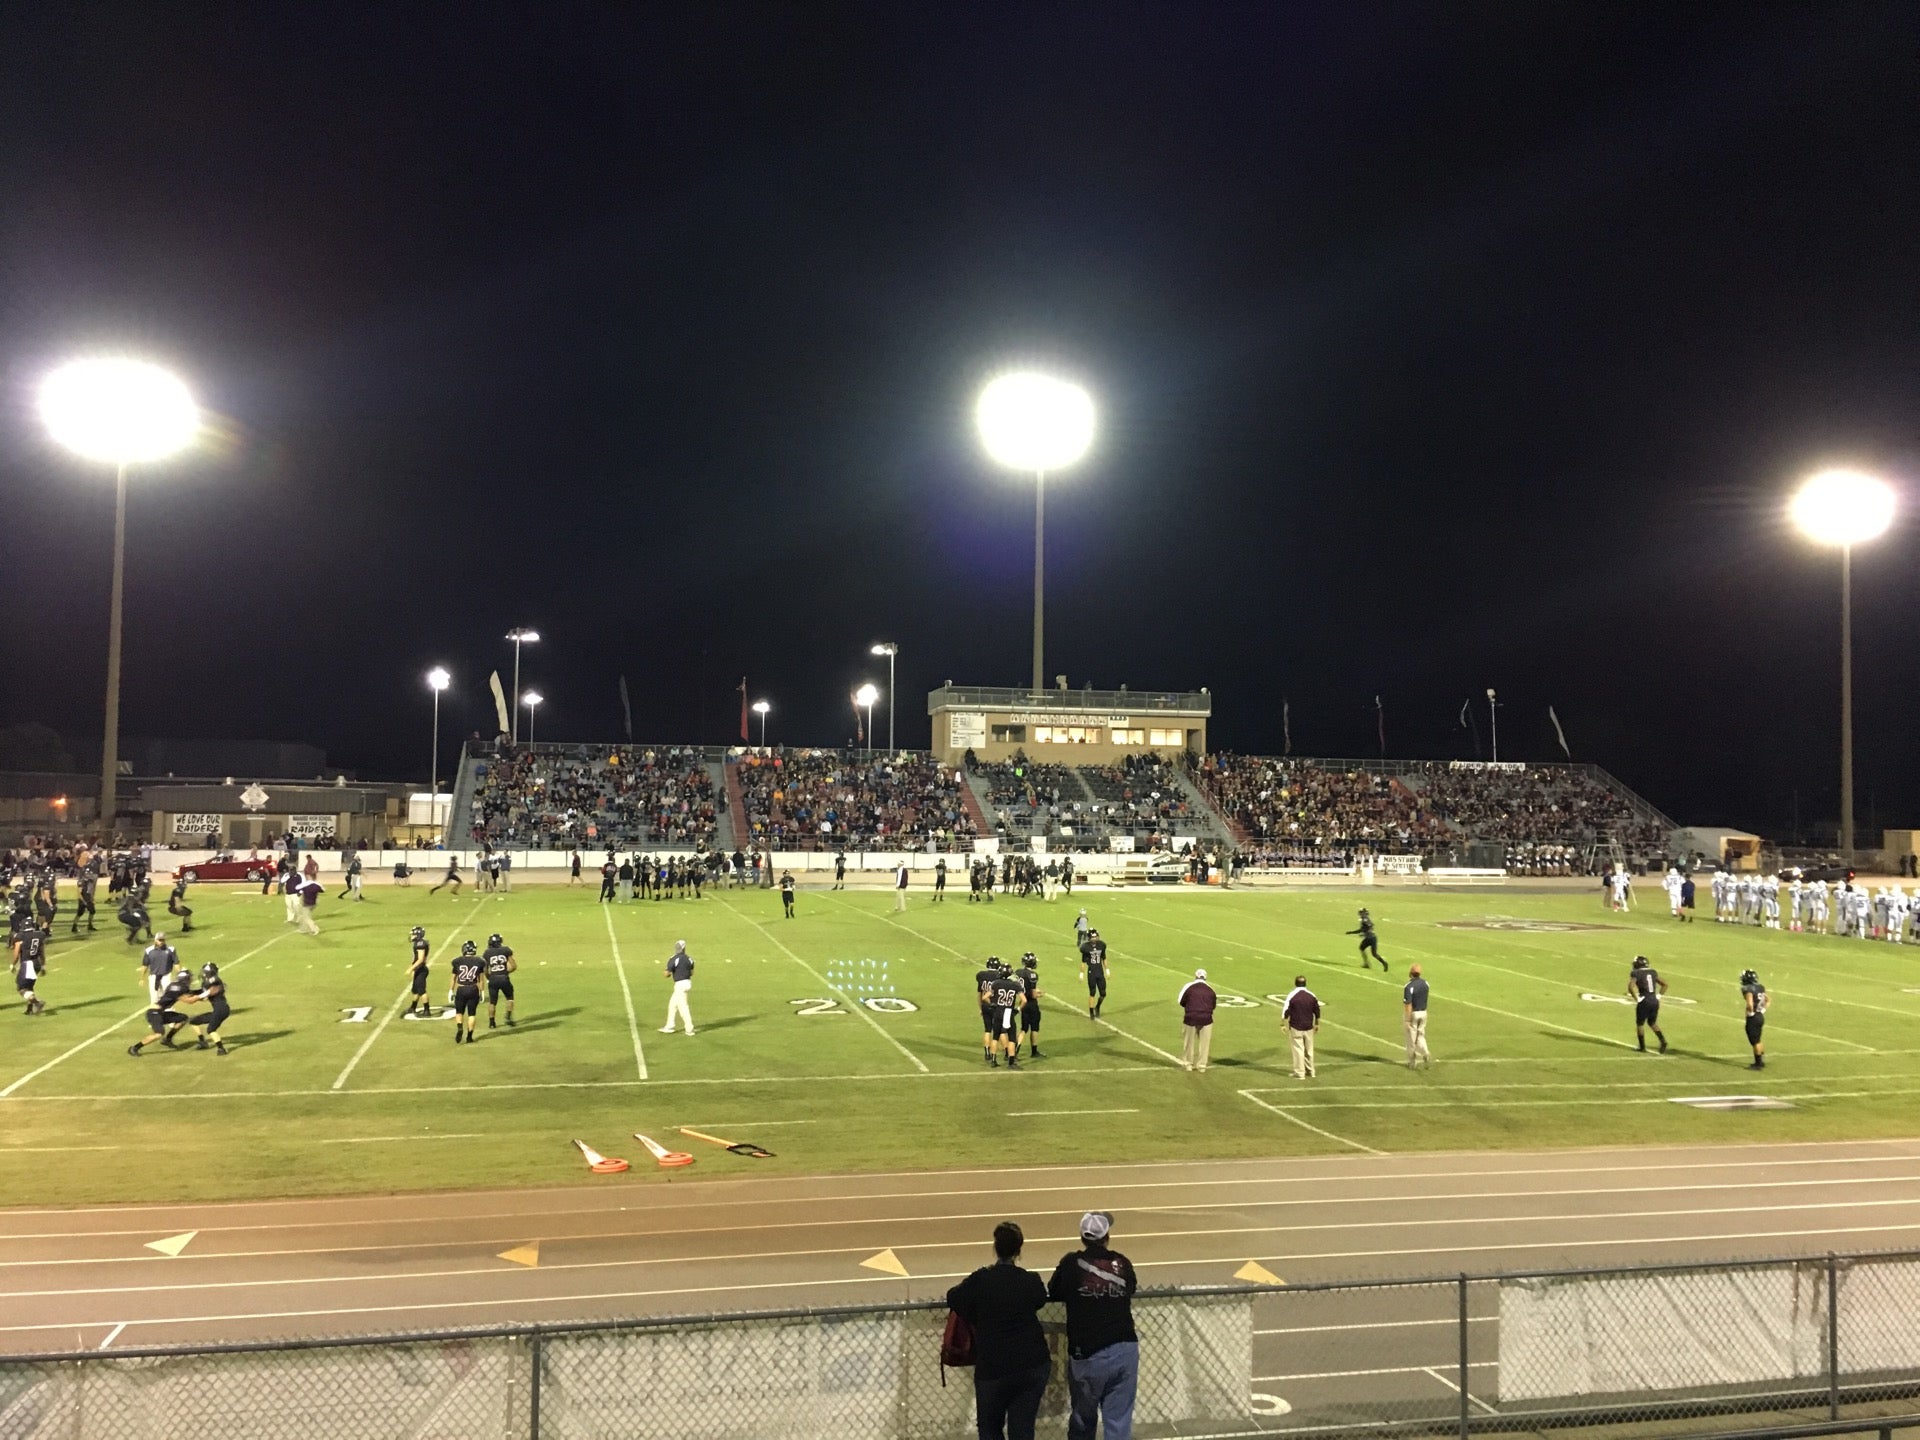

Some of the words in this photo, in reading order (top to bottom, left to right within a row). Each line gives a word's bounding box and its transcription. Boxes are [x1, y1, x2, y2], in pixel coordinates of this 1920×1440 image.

[177, 814, 186, 824] WE
[188, 814, 205, 824] LOVE
[206, 815, 220, 824] OUR
[177, 824, 220, 833] RAIDERS
[291, 825, 334, 834] RAIDERS
[30, 938, 40, 956] 5
[458, 964, 478, 982] 24
[1646, 974, 1654, 993] 1
[788, 997, 919, 1015] 20
[997, 988, 1016, 1007] 26
